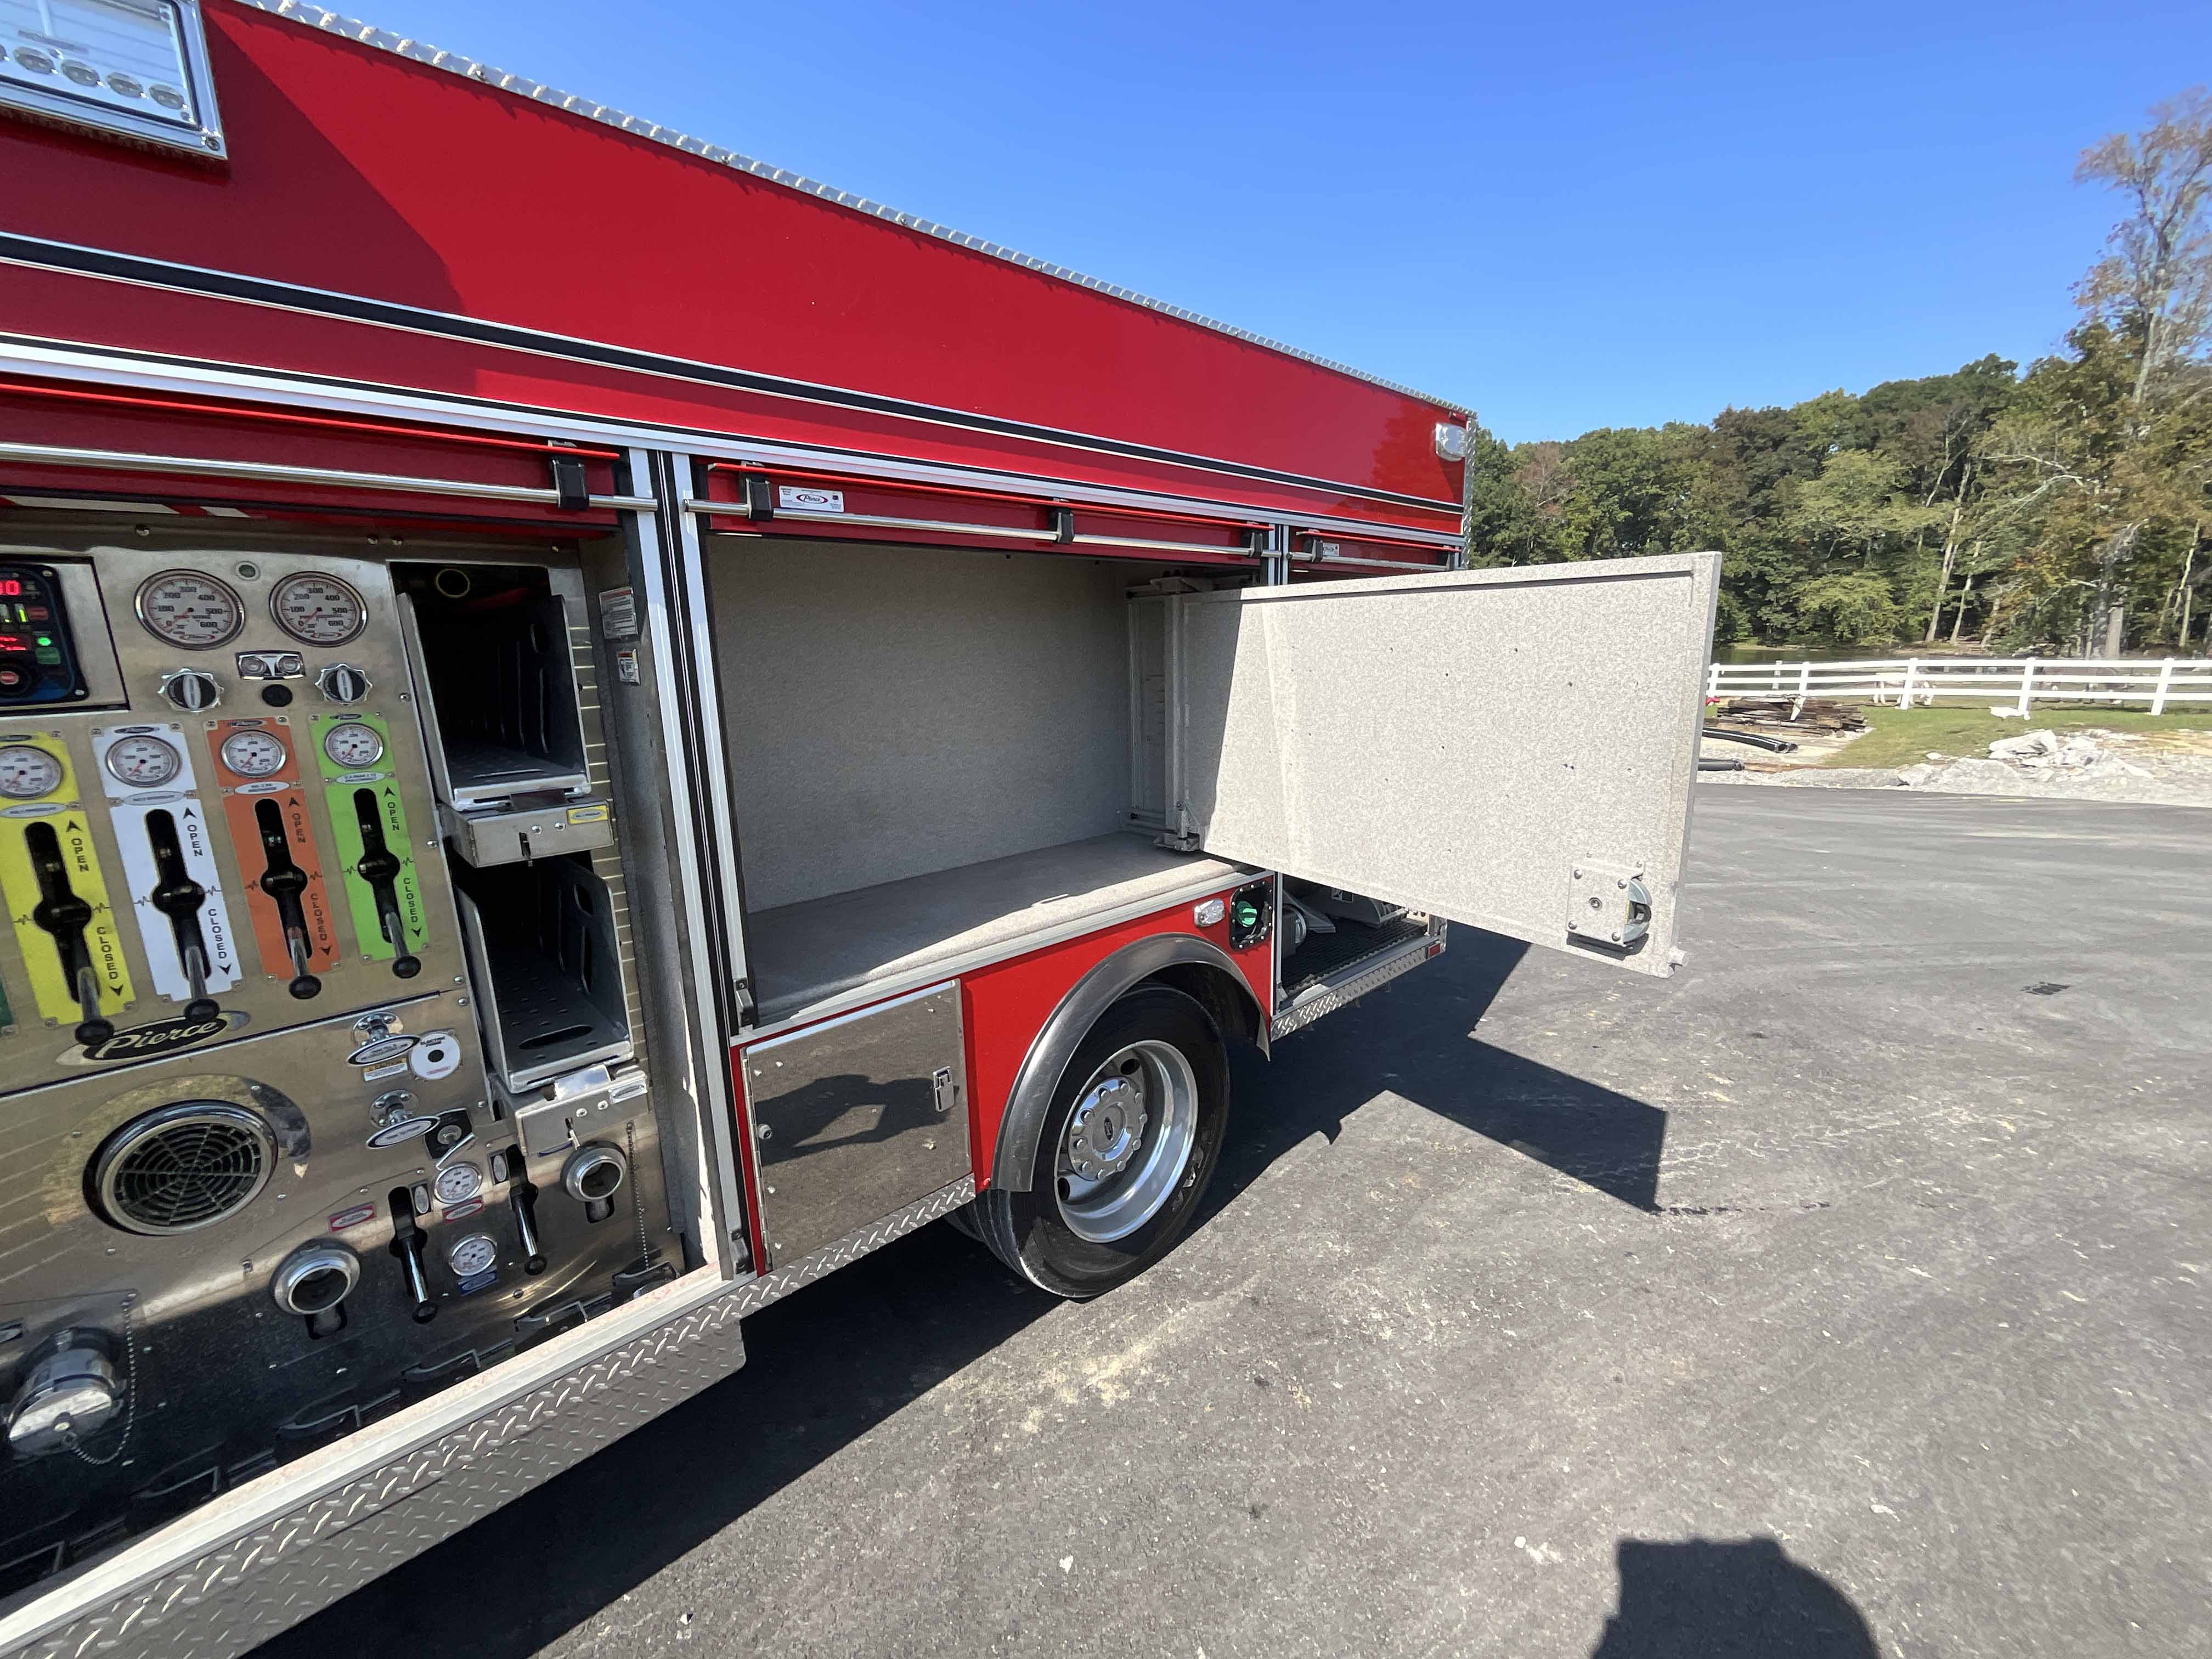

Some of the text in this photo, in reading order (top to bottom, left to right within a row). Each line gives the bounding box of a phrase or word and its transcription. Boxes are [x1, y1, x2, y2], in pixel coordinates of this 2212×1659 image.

[292, 812, 306, 843] OPEN
[387, 802, 400, 831] OPEN
[71, 837, 89, 872] OPEN
[187, 824, 204, 857] OPEN
[311, 893, 328, 941] CLOSED
[403, 877, 418, 923] CLOSED
[97, 926, 119, 980] CLOSED
[208, 908, 227, 960] CLOSED
[94, 1020, 218, 1059] Pierce
